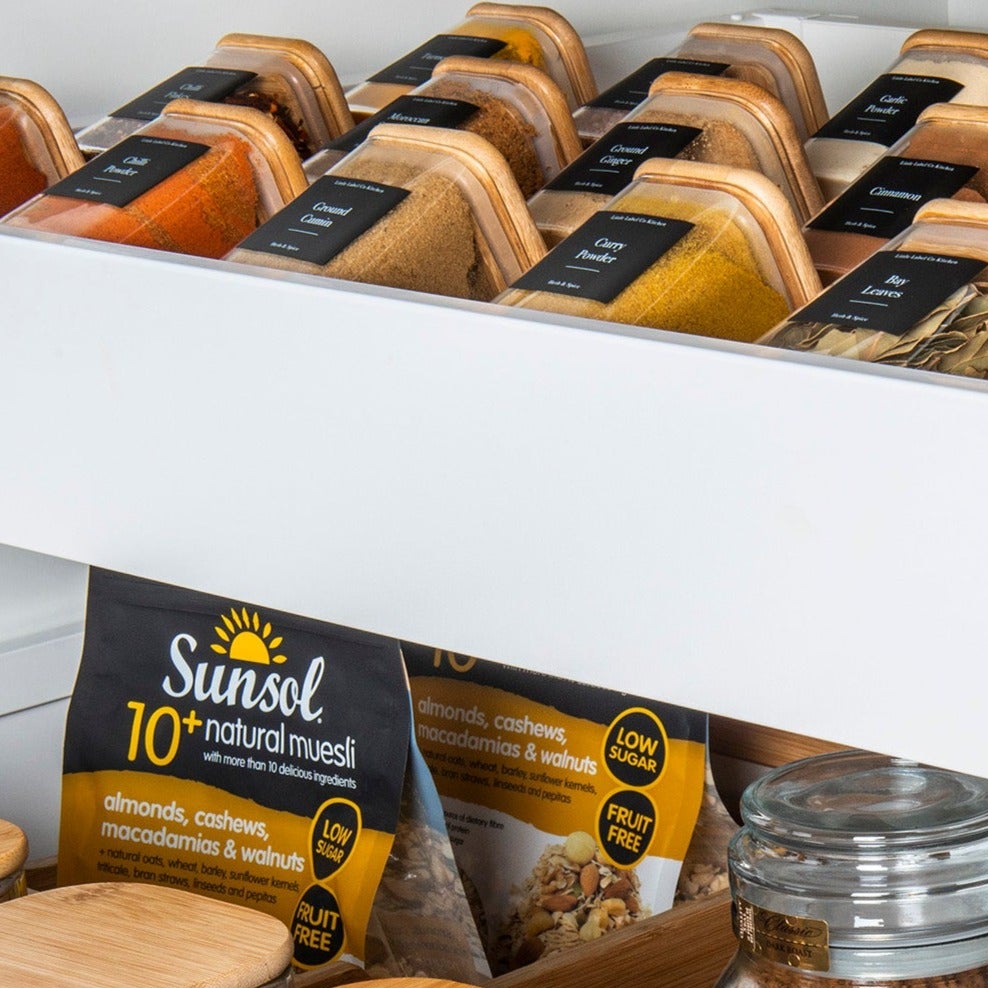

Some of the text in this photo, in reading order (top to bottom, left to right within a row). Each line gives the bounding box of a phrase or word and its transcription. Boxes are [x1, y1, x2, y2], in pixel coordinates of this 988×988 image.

[864, 104, 901, 116] Powder
[879, 94, 909, 105] Garlic
[599, 155, 634, 168] Ginger
[609, 144, 650, 156] Ground
[102, 164, 138, 177] Powder
[869, 186, 923, 202] Cinnamon
[300, 213, 334, 228] Cumin
[312, 201, 353, 217] Ground
[574, 249, 618, 265] Powder
[594, 237, 627, 253] Curry
[860, 285, 904, 299] Leaves
[884, 274, 911, 287] Bay
[161, 632, 325, 724] Sunsol
[418, 697, 567, 745] almonds, cashews,
[205, 717, 285, 754] natural
[289, 735, 356, 770] muesli
[418, 722, 520, 758] macadamias
[524, 743, 537, 762] &
[540, 746, 597, 776] walnuts
[616, 727, 659, 756] LOW
[203, 750, 357, 790] with more than 10 delicious ingredients
[608, 745, 657, 774] SUGAR
[528, 787, 541, 798] and
[542, 789, 571, 804] pepitas
[104, 791, 271, 842] almonds, cashews,
[606, 803, 653, 834] FRUIT
[101, 820, 306, 873] macadamias & walnuts
[322, 819, 353, 847] LOW
[607, 826, 643, 853] FREE
[316, 839, 345, 863] SUGAR
[107, 848, 141, 863] natural
[229, 870, 269, 885] sunflower
[133, 868, 156, 881] bran
[193, 877, 227, 894] linseeds
[227, 885, 244, 898] and
[246, 889, 277, 905] pepitas
[296, 900, 340, 932] FRUIT
[293, 923, 332, 952] FREE
